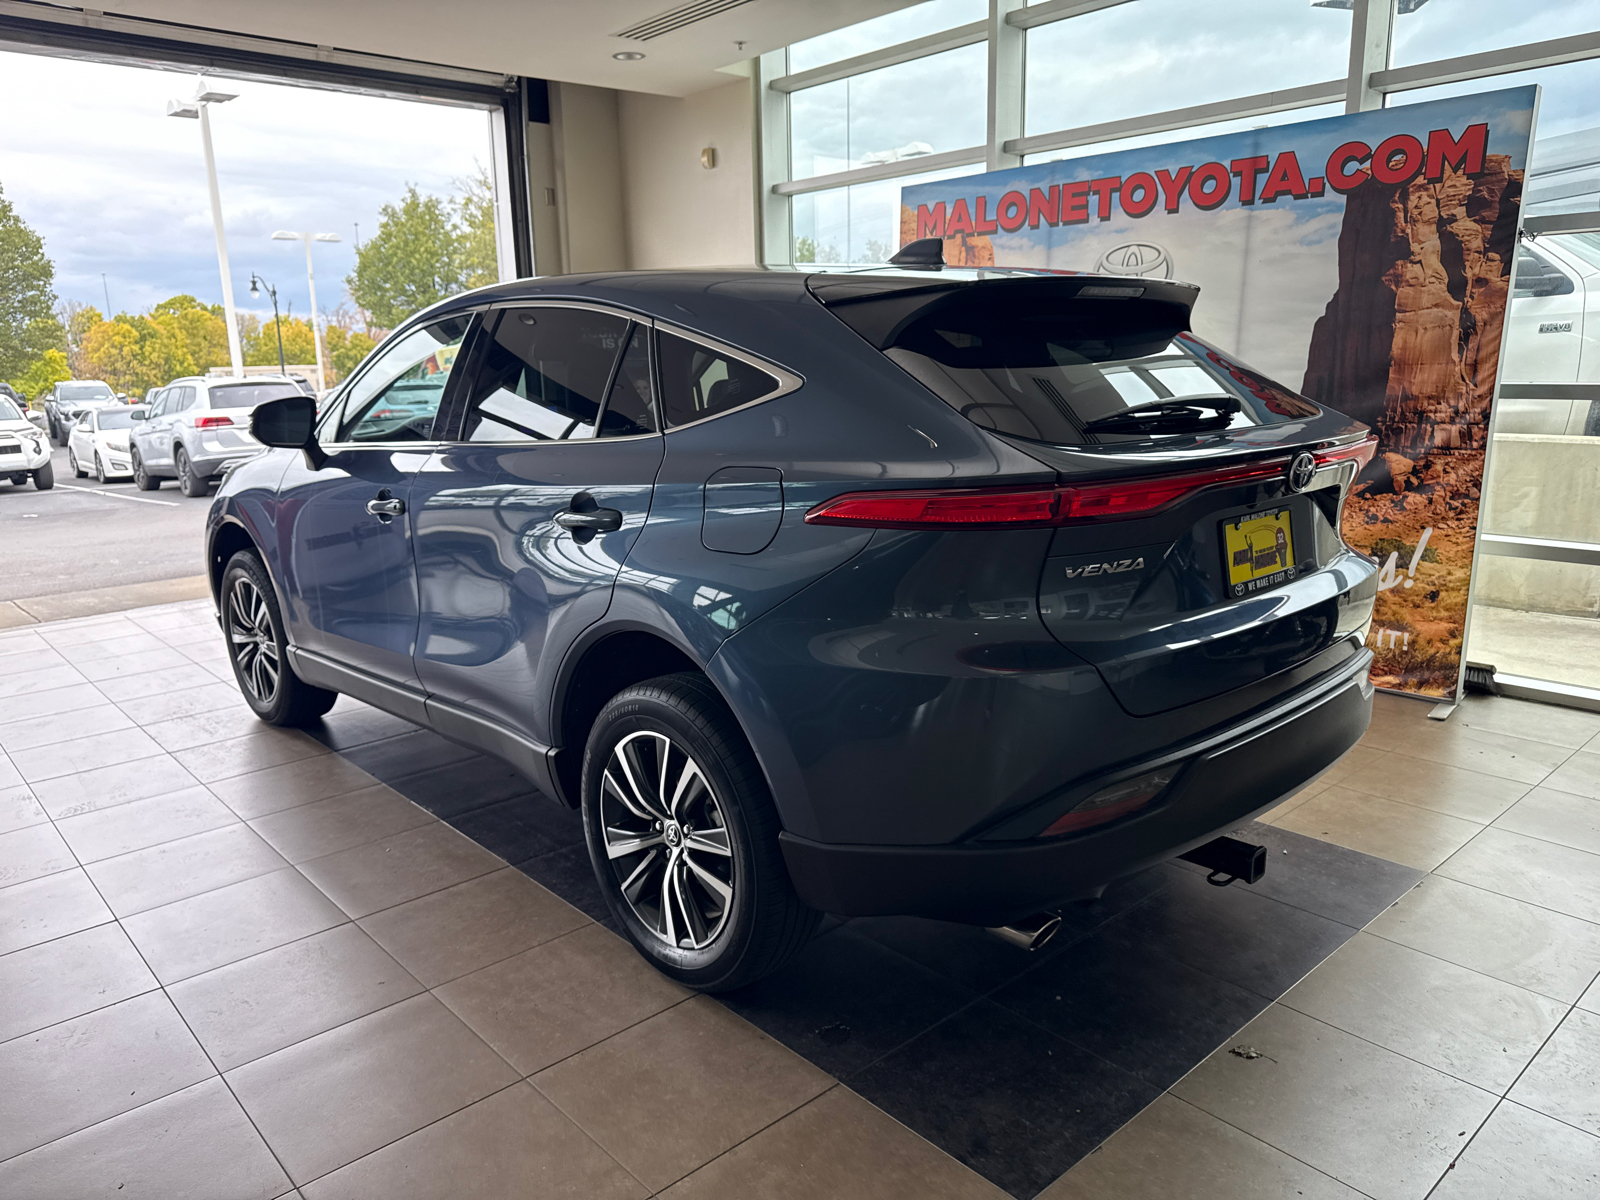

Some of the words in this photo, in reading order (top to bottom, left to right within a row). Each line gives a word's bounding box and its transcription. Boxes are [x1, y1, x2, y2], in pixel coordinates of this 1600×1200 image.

[914, 123, 1490, 240] MALONETOYOTA.COM
[1277, 533, 1284, 543] 32
[1065, 557, 1144, 578] VENZA
[1248, 582, 1256, 591] WE
[1256, 578, 1269, 589] MAKE
[1269, 575, 1274, 584] IT
[1274, 572, 1285, 582] EASY
[1376, 628, 1409, 650] IT!
